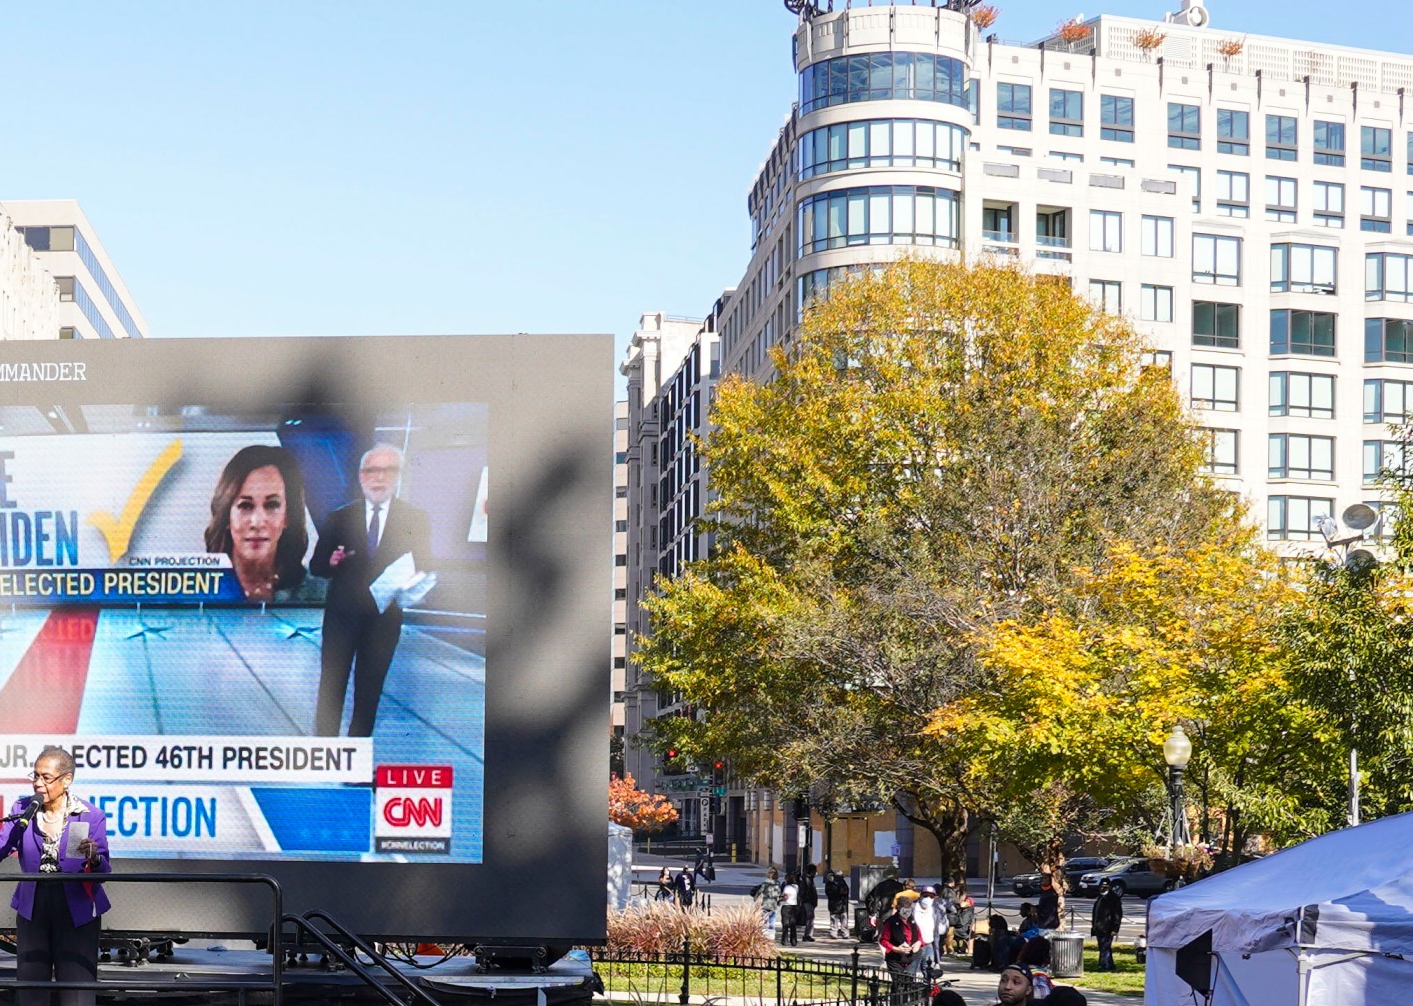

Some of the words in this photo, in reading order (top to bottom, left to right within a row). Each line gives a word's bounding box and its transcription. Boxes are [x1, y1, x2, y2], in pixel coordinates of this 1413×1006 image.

[129, 557, 151, 566] CNN
[154, 556, 220, 566] PROJECTION
[0, 572, 95, 597] ELECTED
[104, 571, 224, 597] PRESIDENT
[0, 744, 34, 768] JR.
[44, 745, 147, 769] ECTED
[155, 745, 213, 769] 46TH
[222, 746, 357, 771] PRESIDENT
[388, 770, 442, 785] LIVE
[384, 797, 442, 828] CNN
